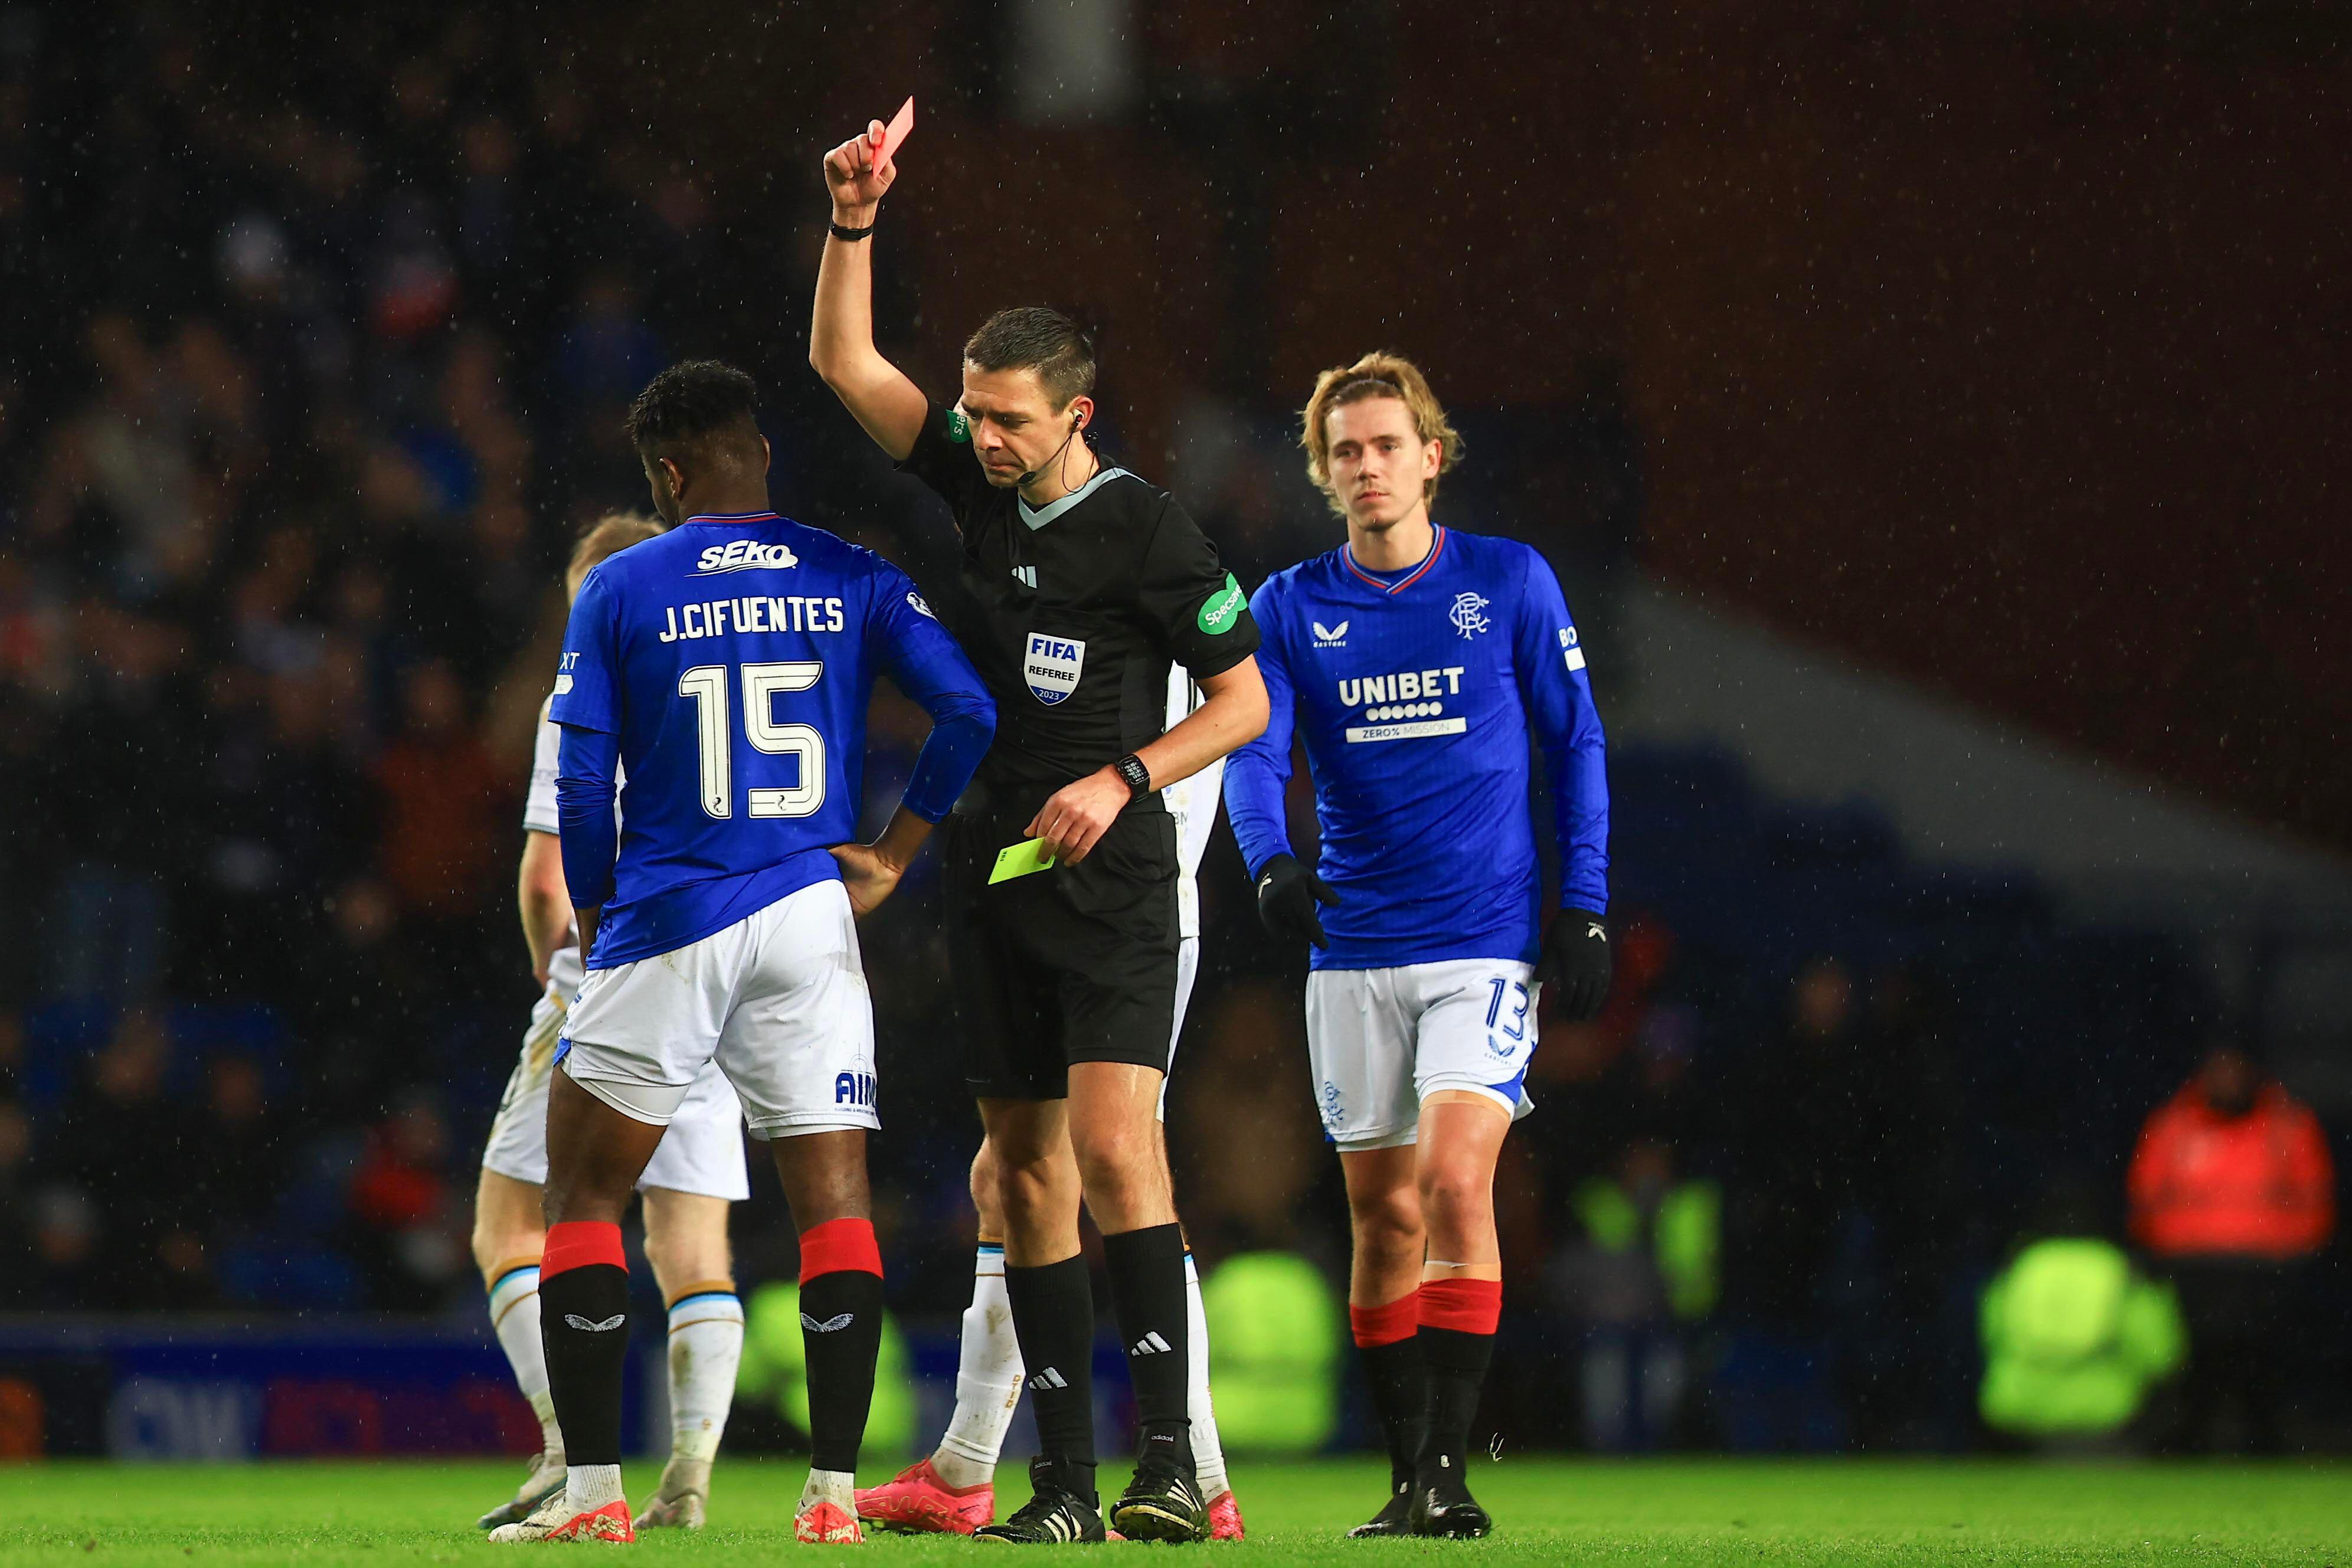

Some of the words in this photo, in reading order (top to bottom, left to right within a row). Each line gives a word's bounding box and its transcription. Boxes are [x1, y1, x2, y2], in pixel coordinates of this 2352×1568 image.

[697, 540, 799, 570] SEKO
[659, 596, 844, 643] J.CIFUENTES
[1032, 638, 1077, 662] FIFA
[1029, 665, 1075, 682] REFEREE
[1339, 666, 1465, 707] UNIBET
[1039, 689, 1059, 700] 2023
[679, 661, 826, 819] 15
[1404, 722, 1450, 735] MISSION
[1486, 978, 1530, 1041] 13
